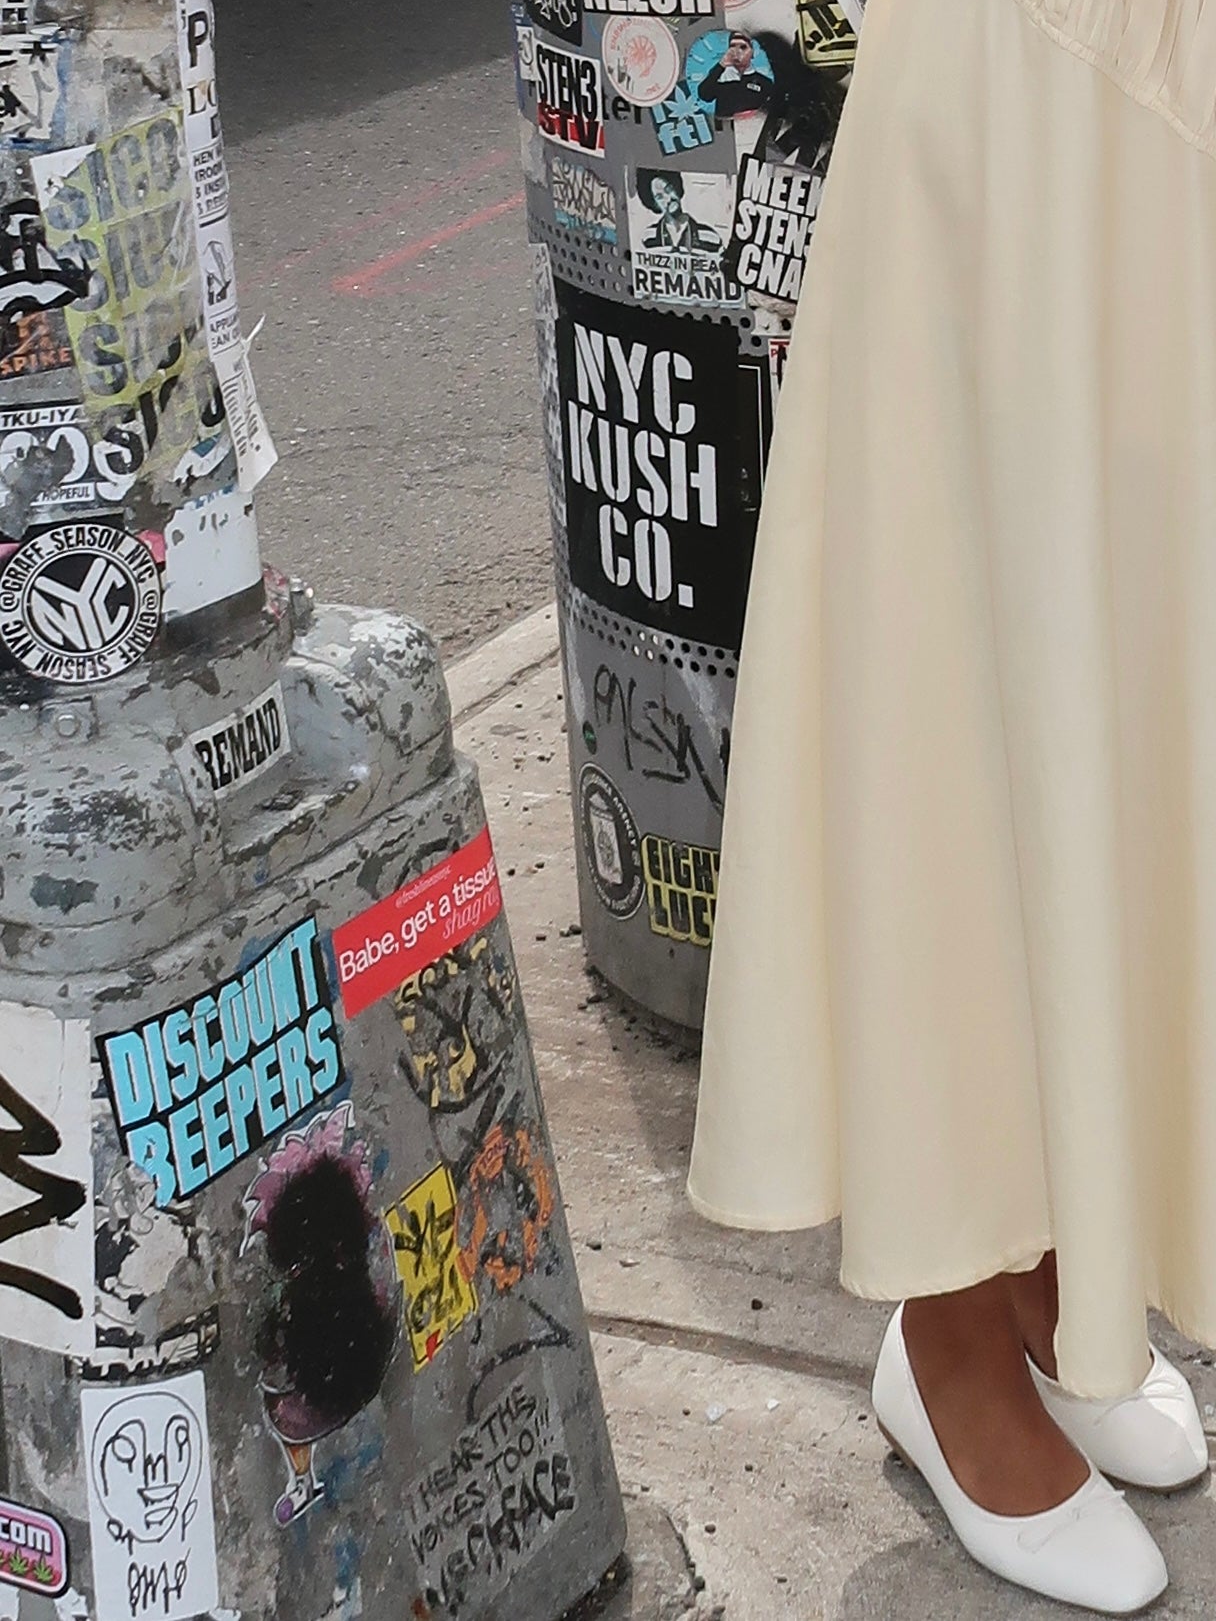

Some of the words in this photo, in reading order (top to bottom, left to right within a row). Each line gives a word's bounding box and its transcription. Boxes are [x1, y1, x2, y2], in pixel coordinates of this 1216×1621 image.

[536, 43, 597, 121] STEN3
[634, 268, 742, 301] REMAND
[635, 252, 671, 268] THIZZ
[674, 256, 688, 270] IN
[574, 322, 696, 434] NYC
[567, 400, 718, 527] KUSH
[599, 504, 695, 608] CO.
[194, 696, 282, 792] REMAND
[338, 932, 400, 983] Babe,
[401, 901, 437, 949] get
[438, 894, 451, 918] a
[104, 925, 322, 1127] DISCOUNT
[125, 1006, 341, 1209] BEEPERS
[419, 1436, 484, 1512] HEAR
[480, 1384, 537, 1448] THE
